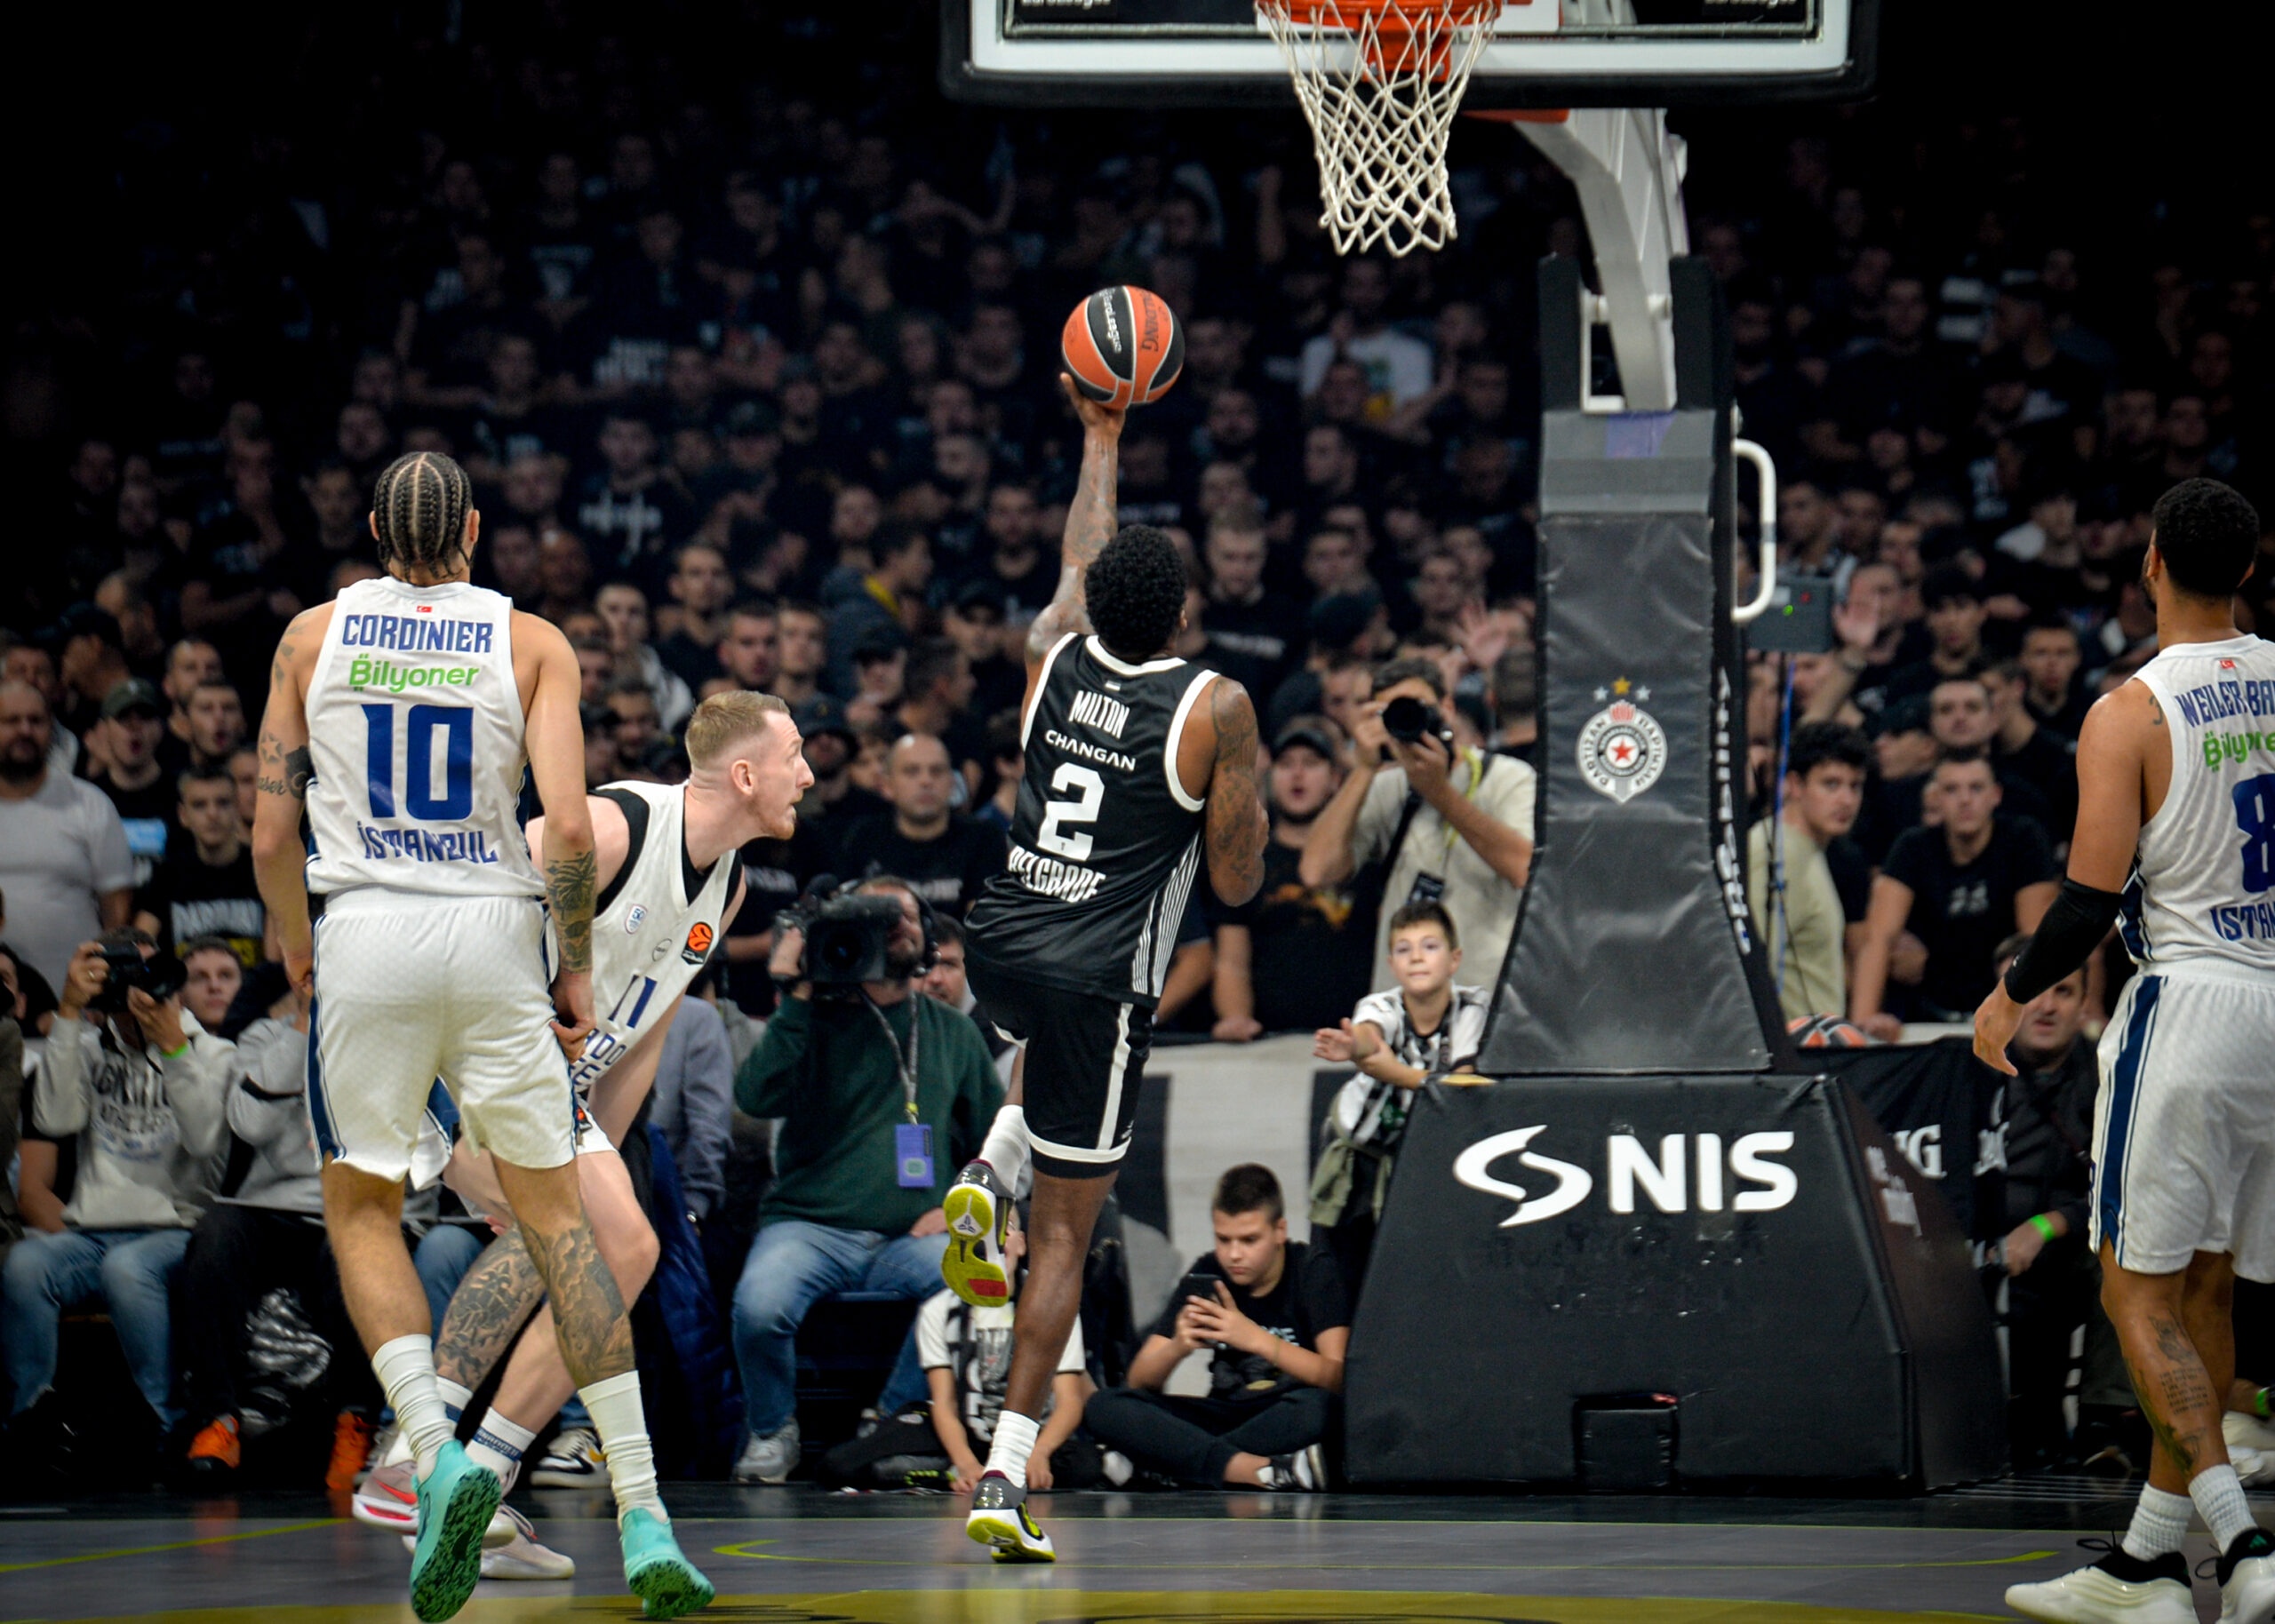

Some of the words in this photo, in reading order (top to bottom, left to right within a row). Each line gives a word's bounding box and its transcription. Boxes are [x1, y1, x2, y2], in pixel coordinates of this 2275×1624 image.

[342, 614, 494, 654] CORDINIER
[348, 653, 480, 694] Bilyoner
[1068, 689, 1130, 739] MILTON
[360, 703, 475, 821] 10
[1044, 728, 1137, 772] CHANGAN
[1036, 761, 1106, 862] 2
[1607, 1130, 1798, 1214] NIS
